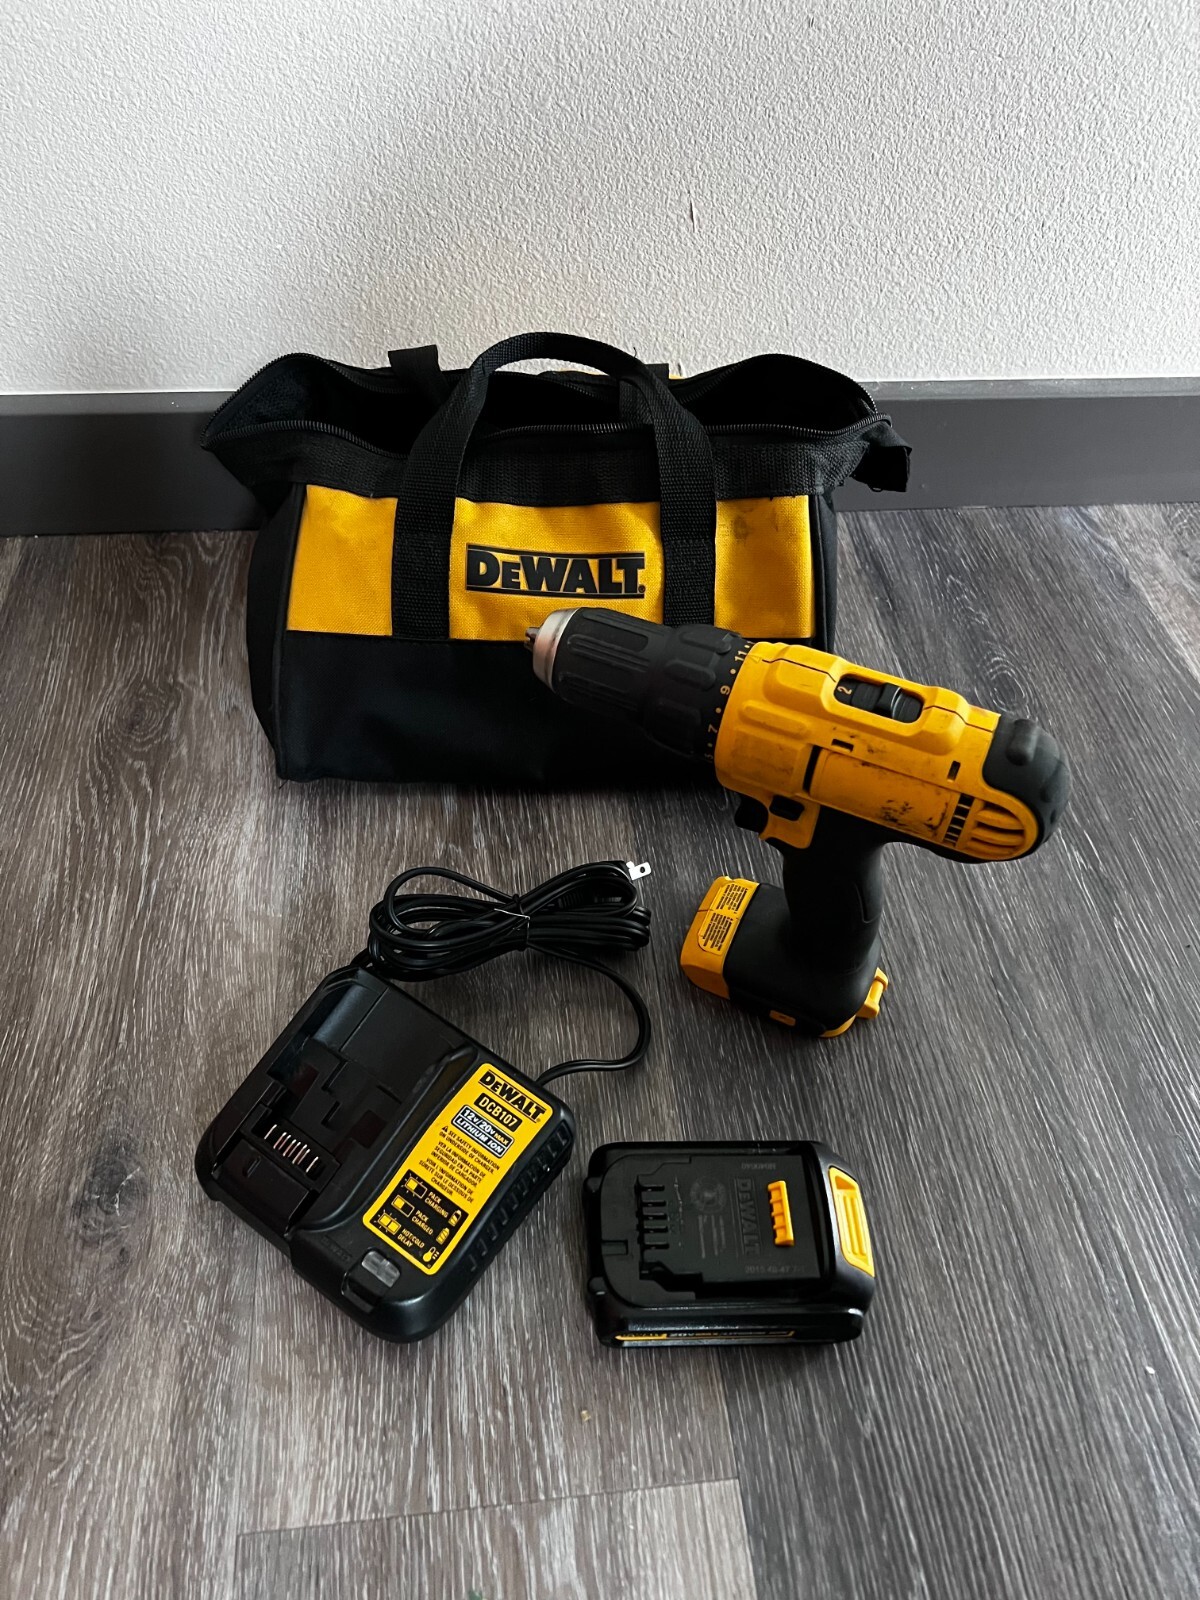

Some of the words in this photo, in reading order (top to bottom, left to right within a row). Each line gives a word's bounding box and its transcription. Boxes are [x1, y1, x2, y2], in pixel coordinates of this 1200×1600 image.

[735, 650, 748, 661] 11
[720, 685, 730, 695] 9
[837, 686, 853, 695] 2
[708, 724, 718, 733] 7
[478, 1096, 517, 1128] DCB107
[456, 1116, 488, 1142] LITHIUM
[487, 1139, 503, 1153] ION
[493, 1132, 508, 1145] MAX
[437, 1140, 446, 1149] VER
[445, 1135, 469, 1155] UNDERSIDE
[448, 1130, 457, 1138] SEE
[455, 1135, 472, 1149] SAFETY
[470, 1147, 500, 1170] INFORMATION
[428, 1191, 441, 1203] PACK
[423, 1196, 449, 1218] CHARGING
[415, 1210, 428, 1222] PACK
[410, 1215, 433, 1235] CHARGED
[397, 1233, 413, 1248] DELAY
[401, 1227, 425, 1249] HOT/COLD
